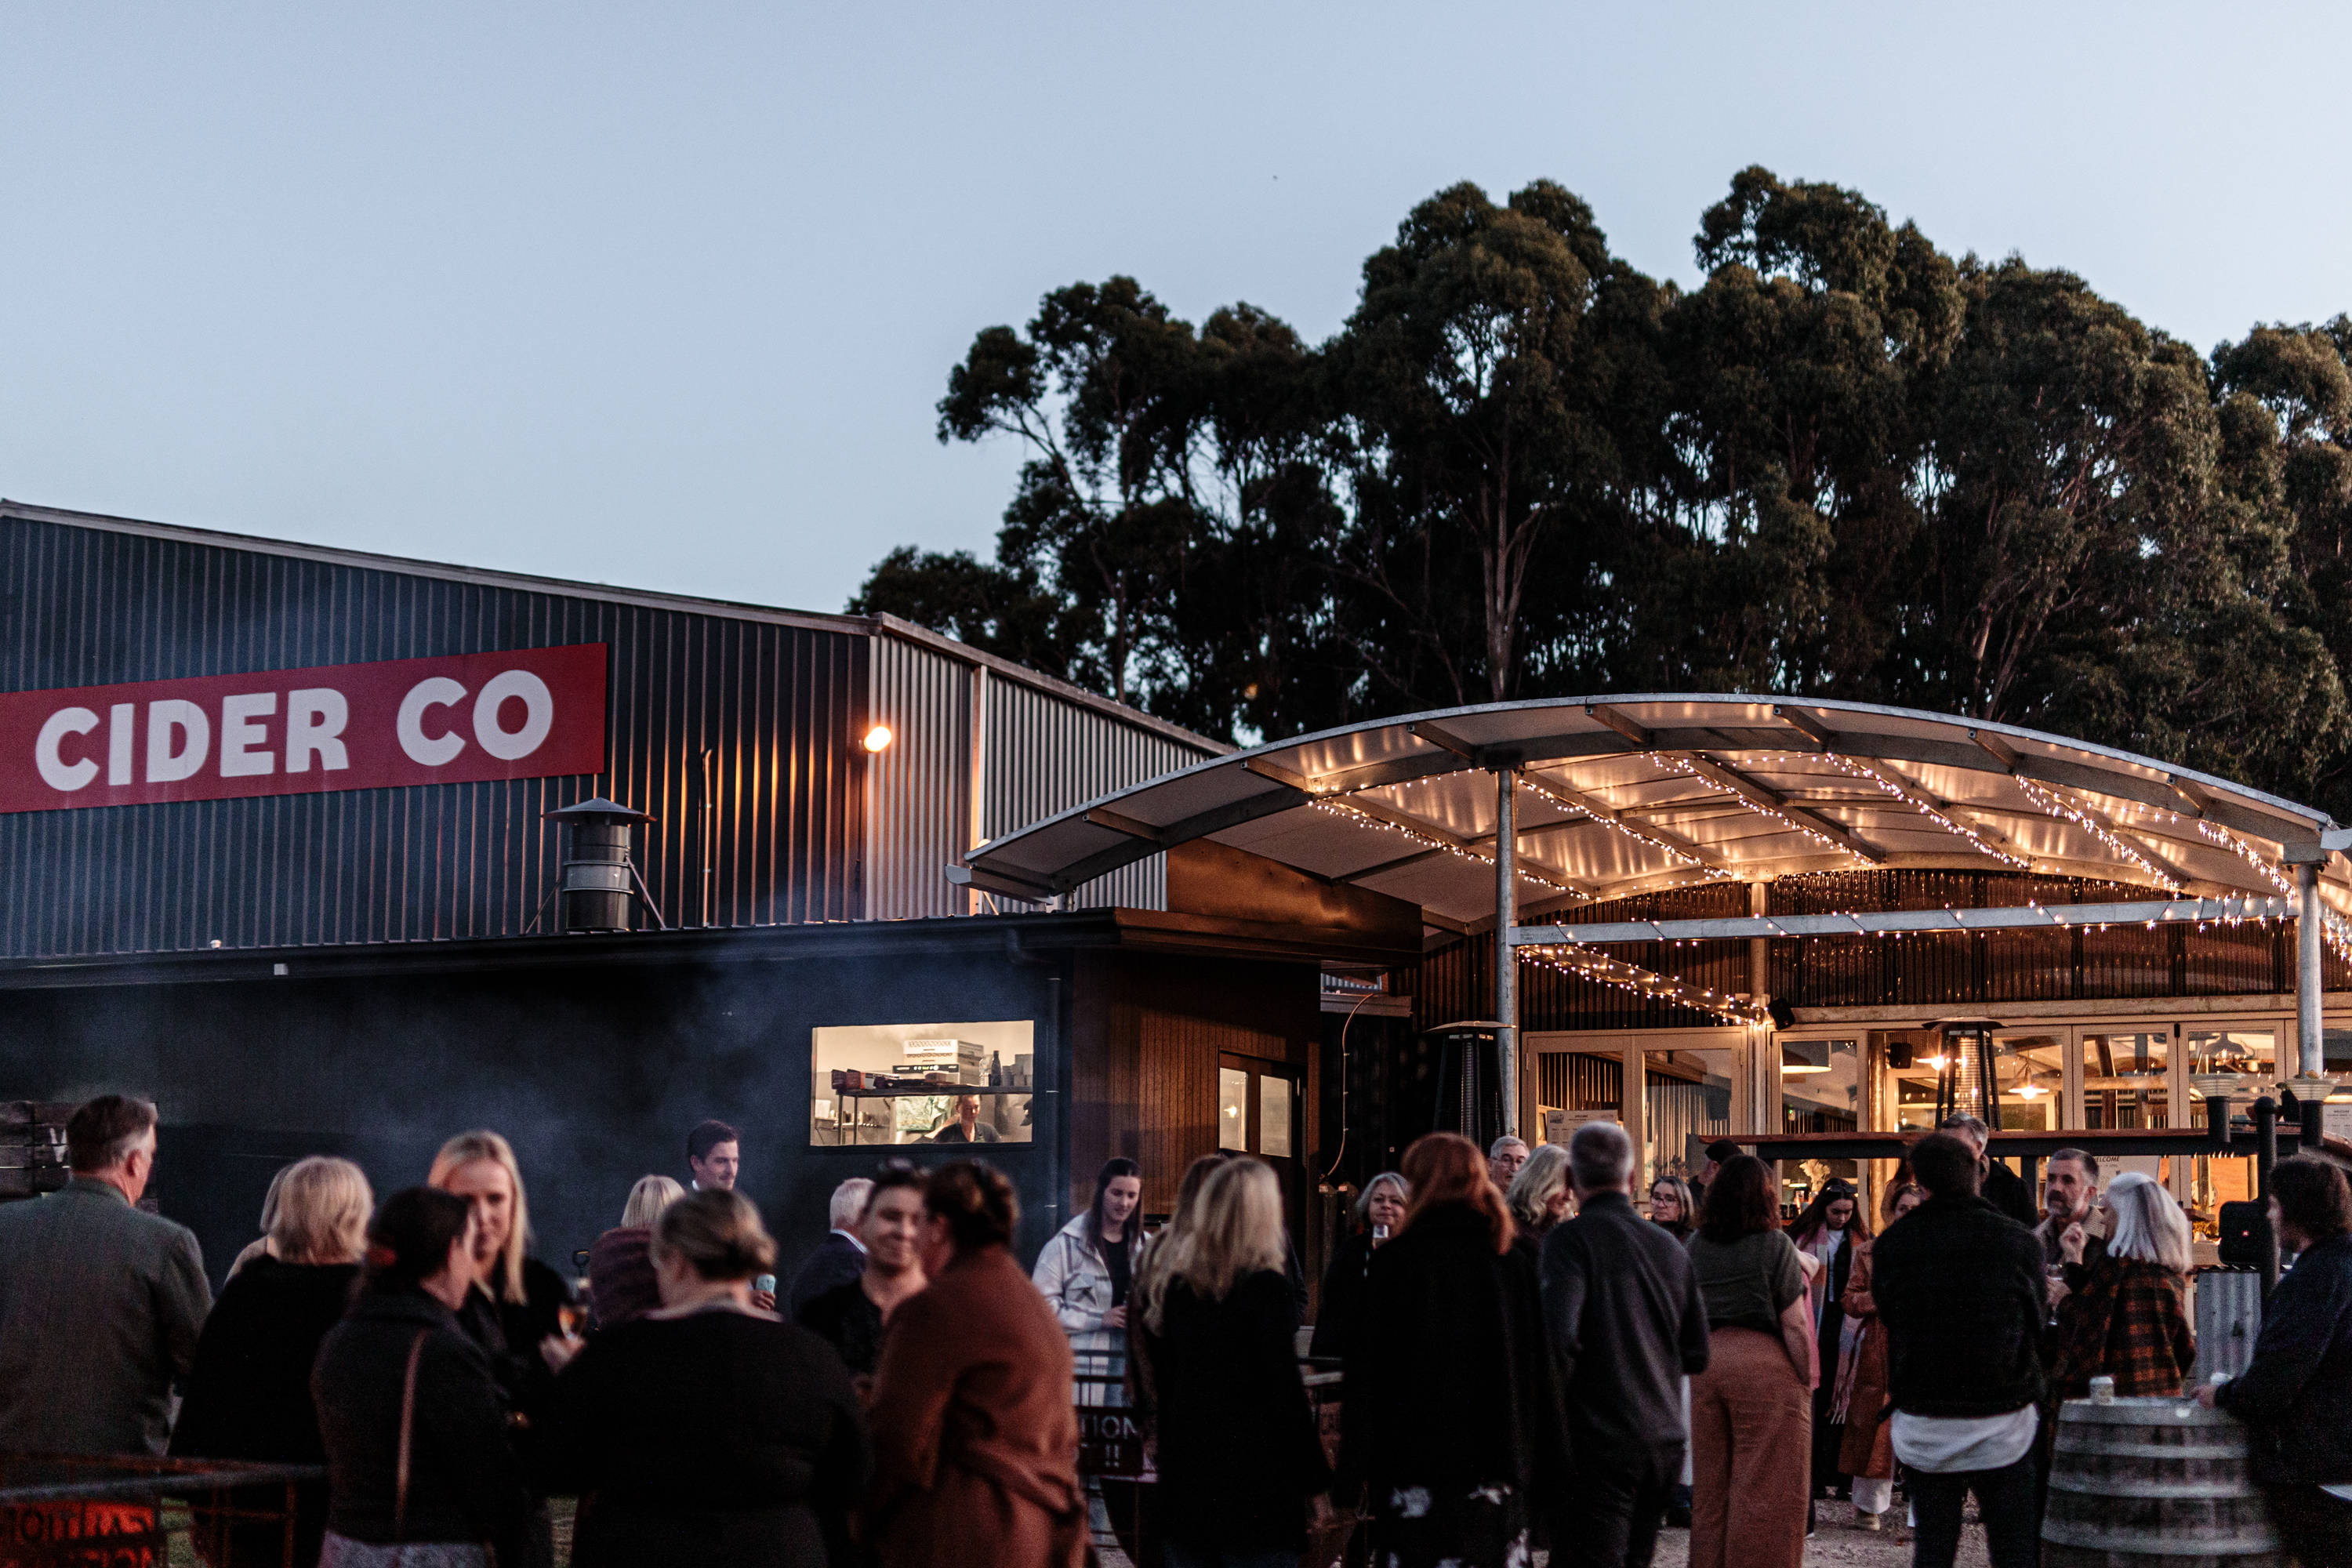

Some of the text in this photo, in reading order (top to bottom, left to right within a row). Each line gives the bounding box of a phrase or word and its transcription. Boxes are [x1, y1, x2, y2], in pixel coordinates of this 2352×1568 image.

[35, 669, 554, 792] CIDER CO
[1079, 1413, 1138, 1439] TION
